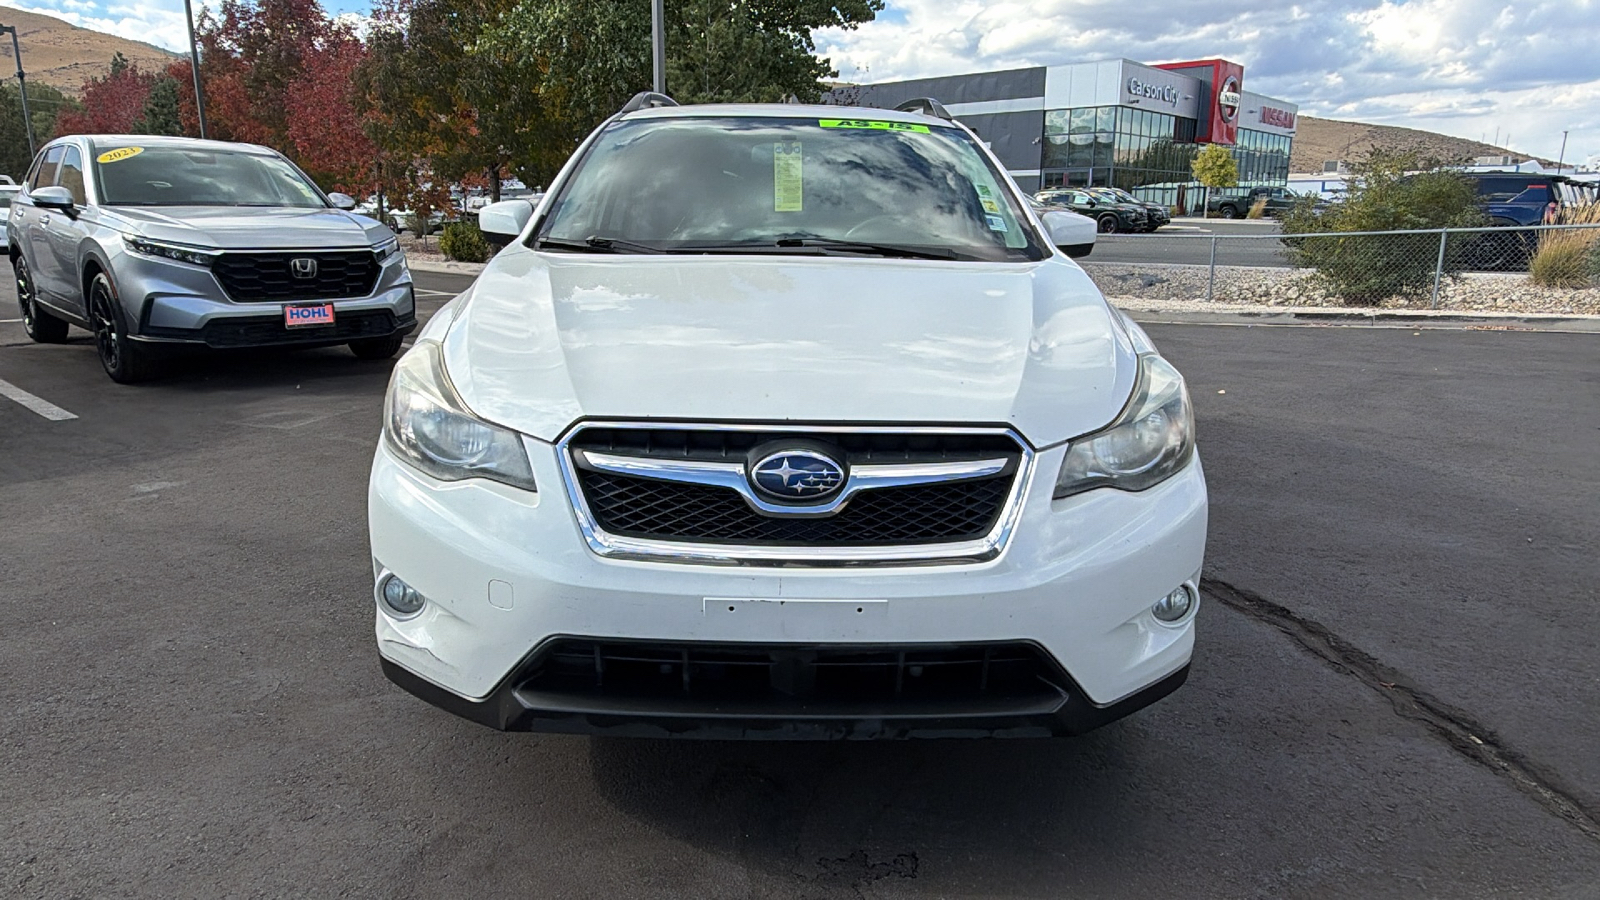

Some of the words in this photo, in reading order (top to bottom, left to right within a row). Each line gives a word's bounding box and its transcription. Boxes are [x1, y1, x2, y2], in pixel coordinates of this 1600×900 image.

[1129, 77, 1162, 100] Carson
[1163, 85, 1180, 108] City
[1261, 106, 1295, 129] NISSAN
[106, 147, 136, 160] 2023
[289, 307, 329, 319] HOHL
